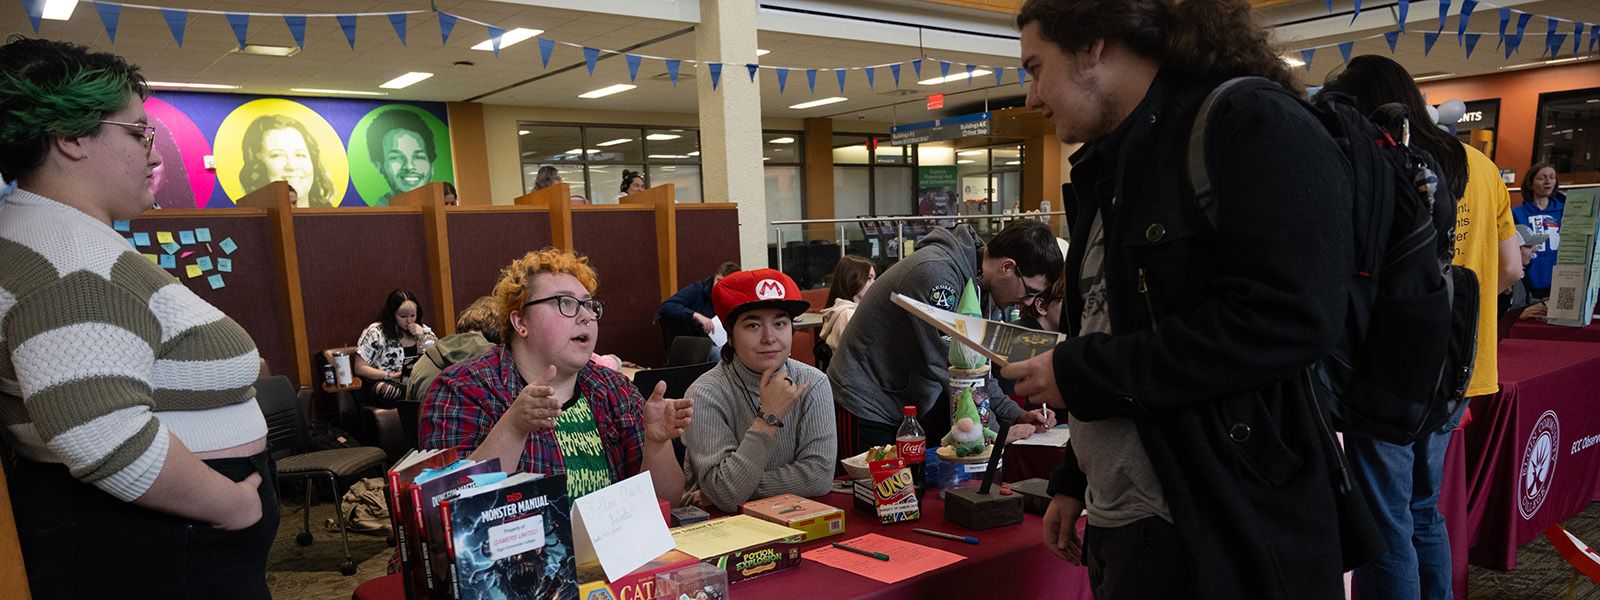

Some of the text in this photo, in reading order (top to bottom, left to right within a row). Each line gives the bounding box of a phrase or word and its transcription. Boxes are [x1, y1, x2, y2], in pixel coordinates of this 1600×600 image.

[759, 281, 783, 297] M
[931, 284, 956, 294] APOLLO
[1570, 438, 1583, 455] ECC
[876, 467, 913, 500] UNO
[481, 495, 550, 523] MONSTER MANUAL
[493, 534, 518, 546] GAMERS
[736, 552, 782, 571] EXPLOSION
[743, 549, 774, 562] POTION
